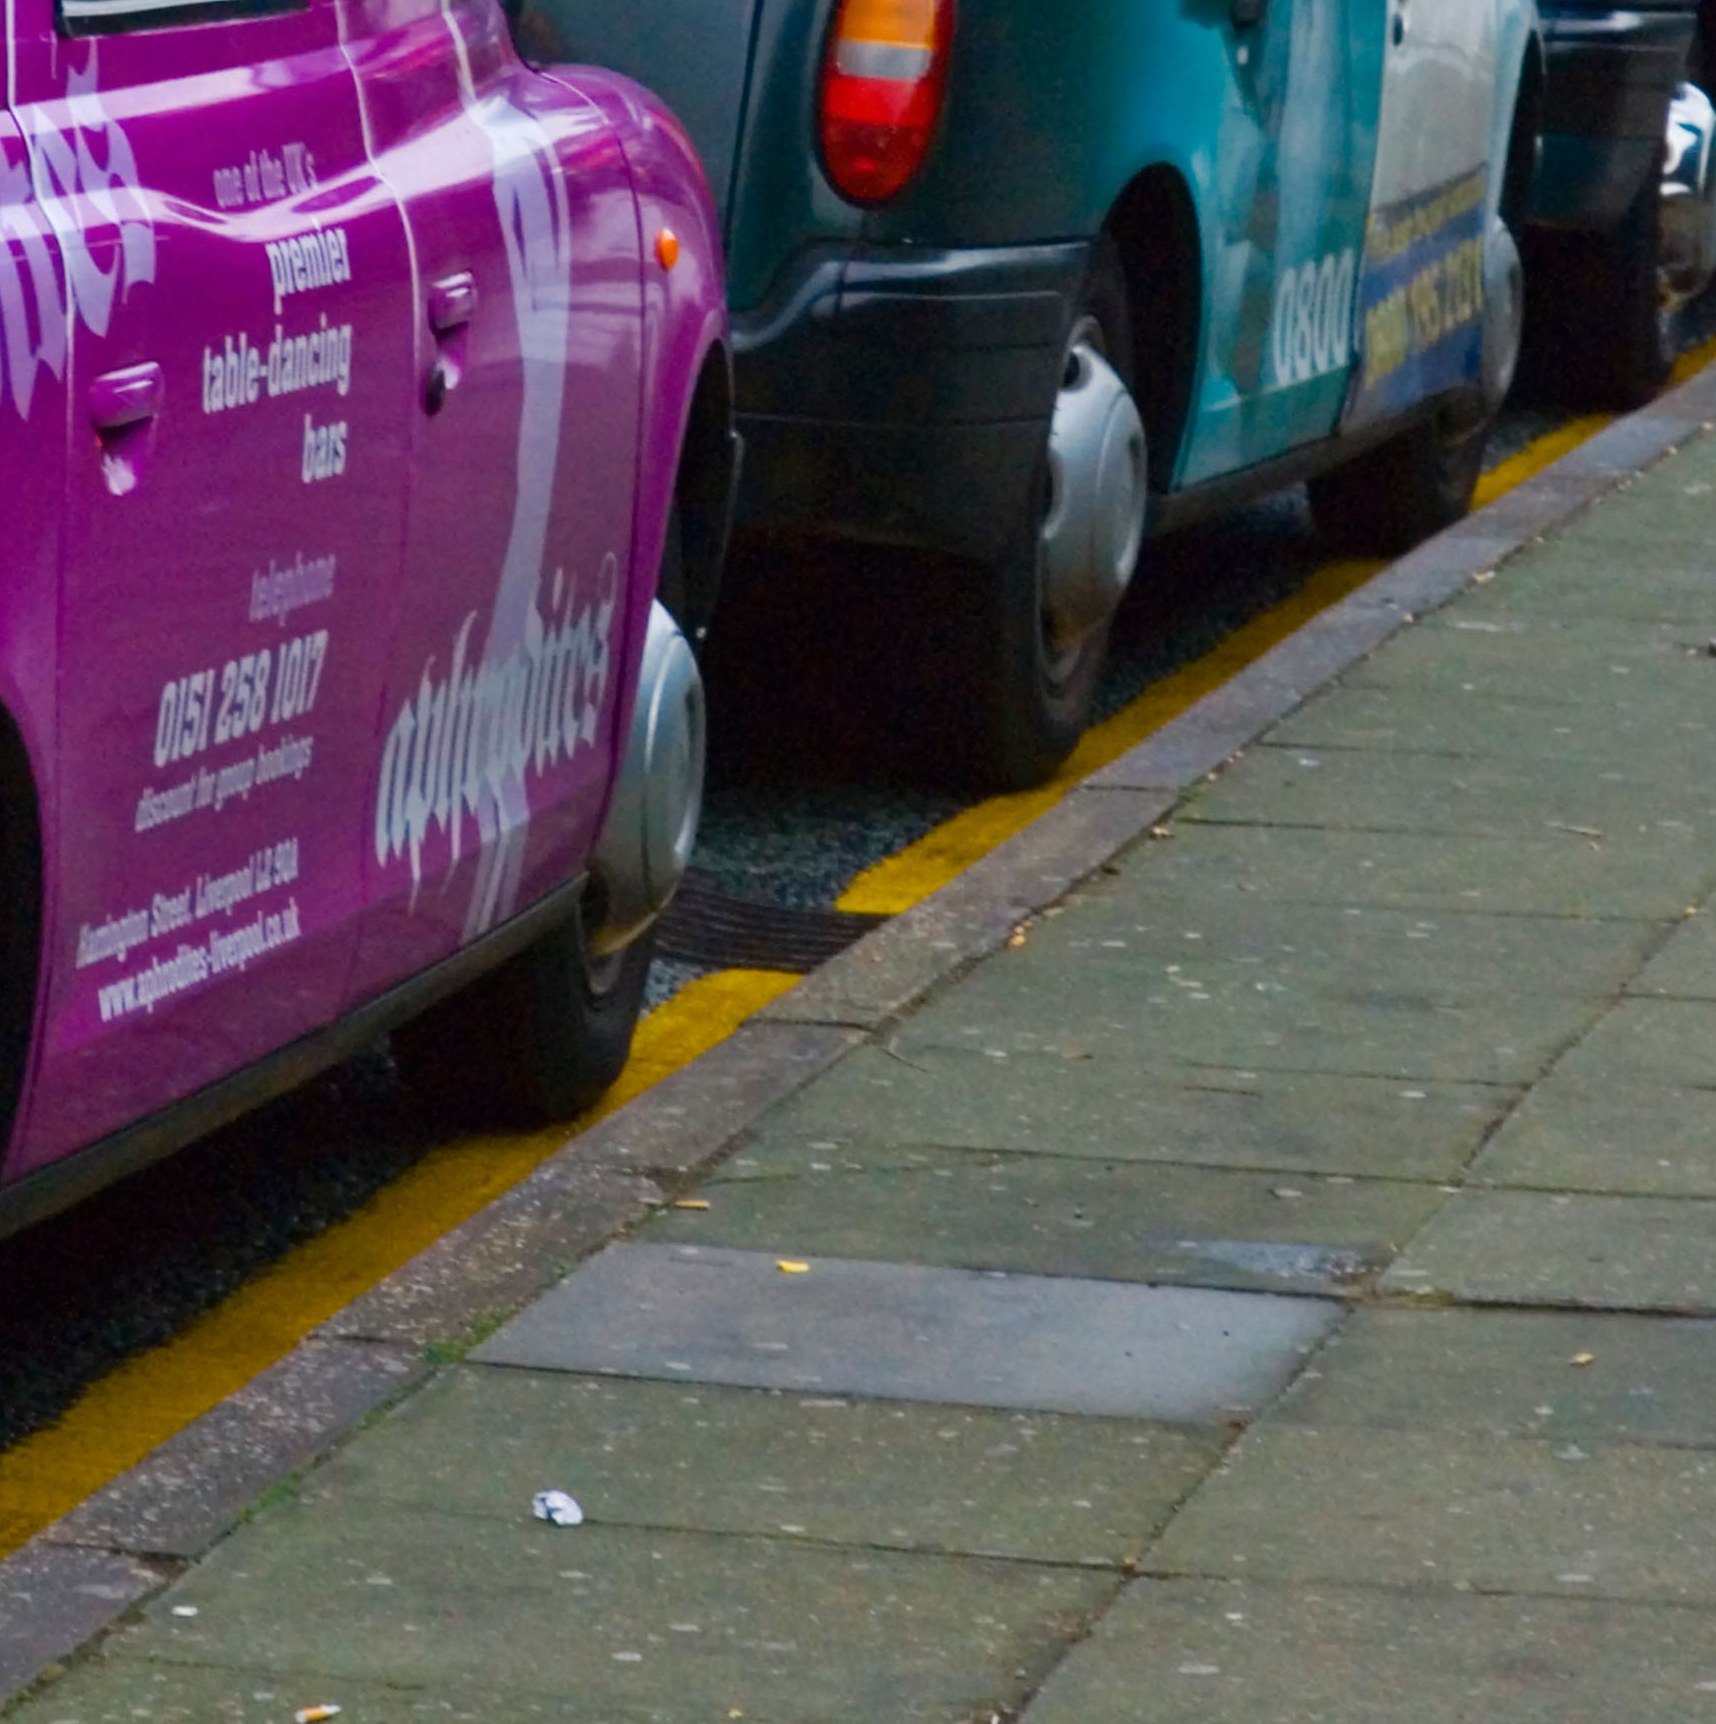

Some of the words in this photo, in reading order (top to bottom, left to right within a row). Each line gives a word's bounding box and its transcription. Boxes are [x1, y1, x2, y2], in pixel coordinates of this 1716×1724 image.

[265, 216, 352, 316] premier
[201, 311, 353, 415] table-dancing
[300, 413, 348, 485] bars
[153, 669, 217, 768] 0151
[214, 648, 273, 745] 258
[270, 629, 329, 725] 1017
